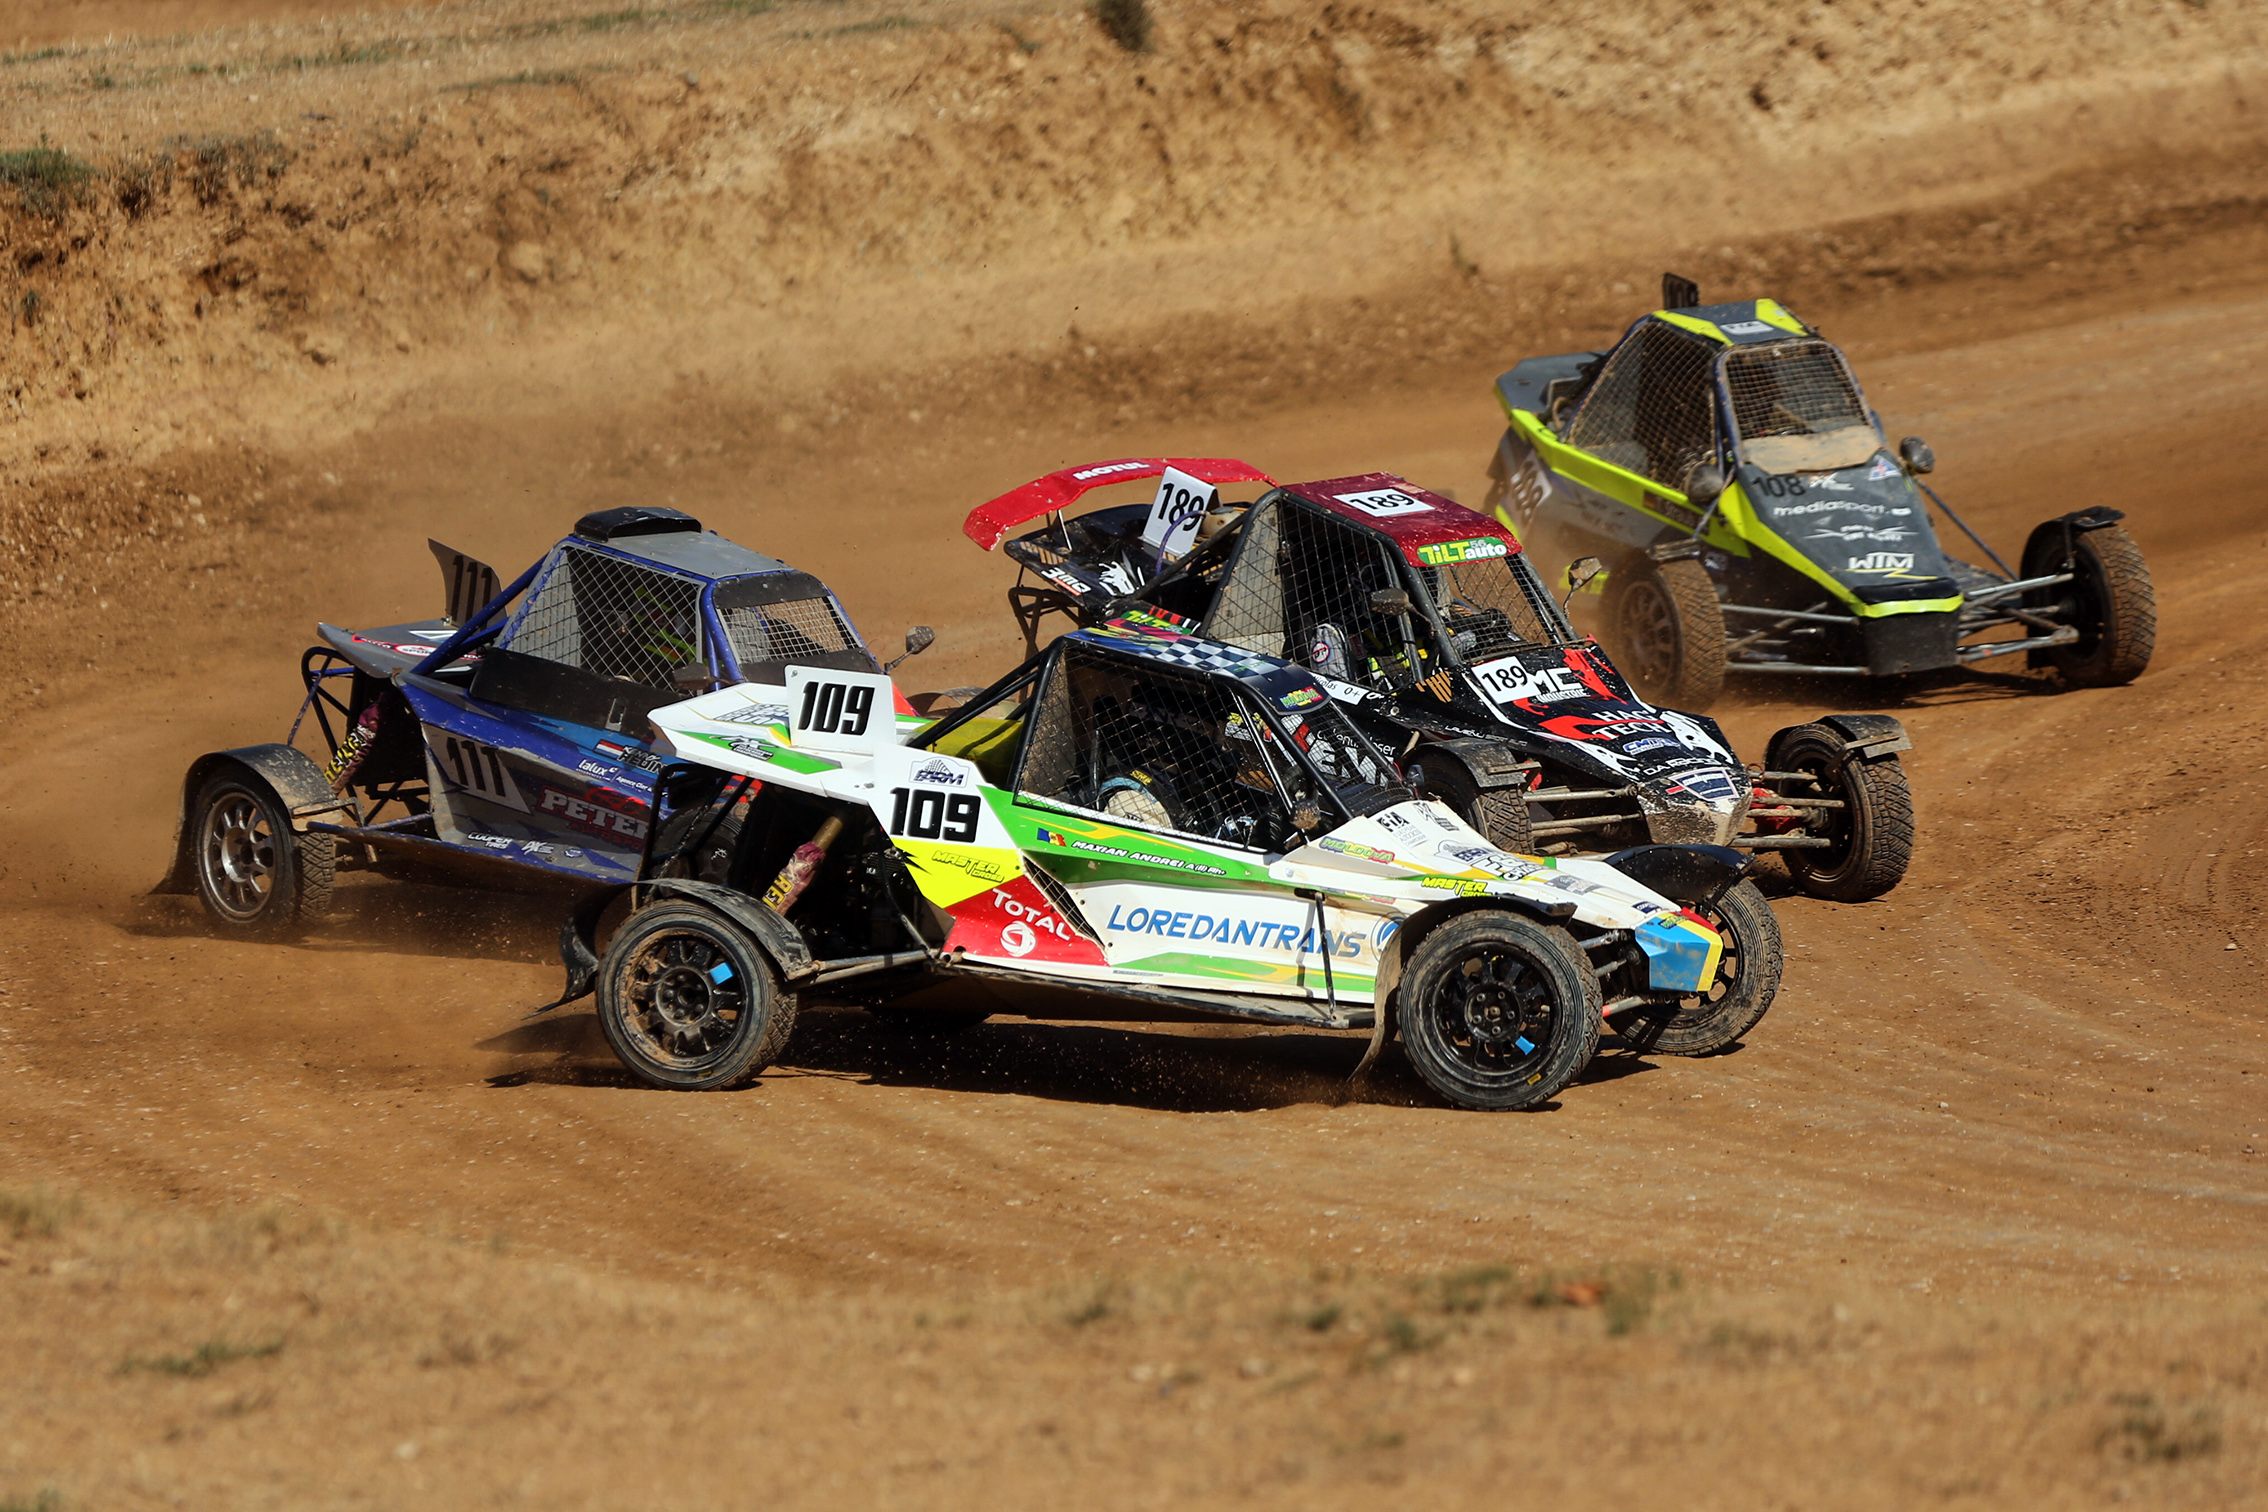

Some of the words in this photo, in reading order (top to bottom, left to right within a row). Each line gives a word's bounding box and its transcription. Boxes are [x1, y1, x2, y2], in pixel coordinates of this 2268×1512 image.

[1073, 461, 1150, 481] MOTUL
[1753, 475, 1806, 497] 108
[1157, 482, 1204, 532] 189
[1349, 493, 1415, 510] 189
[1465, 544, 1508, 560] auto
[449, 555, 492, 623] 111
[1482, 664, 1529, 693] 189
[797, 681, 875, 736] 109
[1592, 722, 1673, 740] TECH
[446, 736, 506, 797] 111
[578, 759, 608, 776] lalux
[890, 787, 981, 843] 109
[932, 850, 1000, 874] MASTER
[1072, 841, 1128, 857] MAXIAN
[1129, 853, 1185, 868] ANDREI
[1320, 837, 1394, 863] MOLDOVA
[1421, 877, 1488, 895] MASTER
[992, 888, 1070, 941] TOTAL
[1107, 904, 1369, 957] LOREDANTRANS
